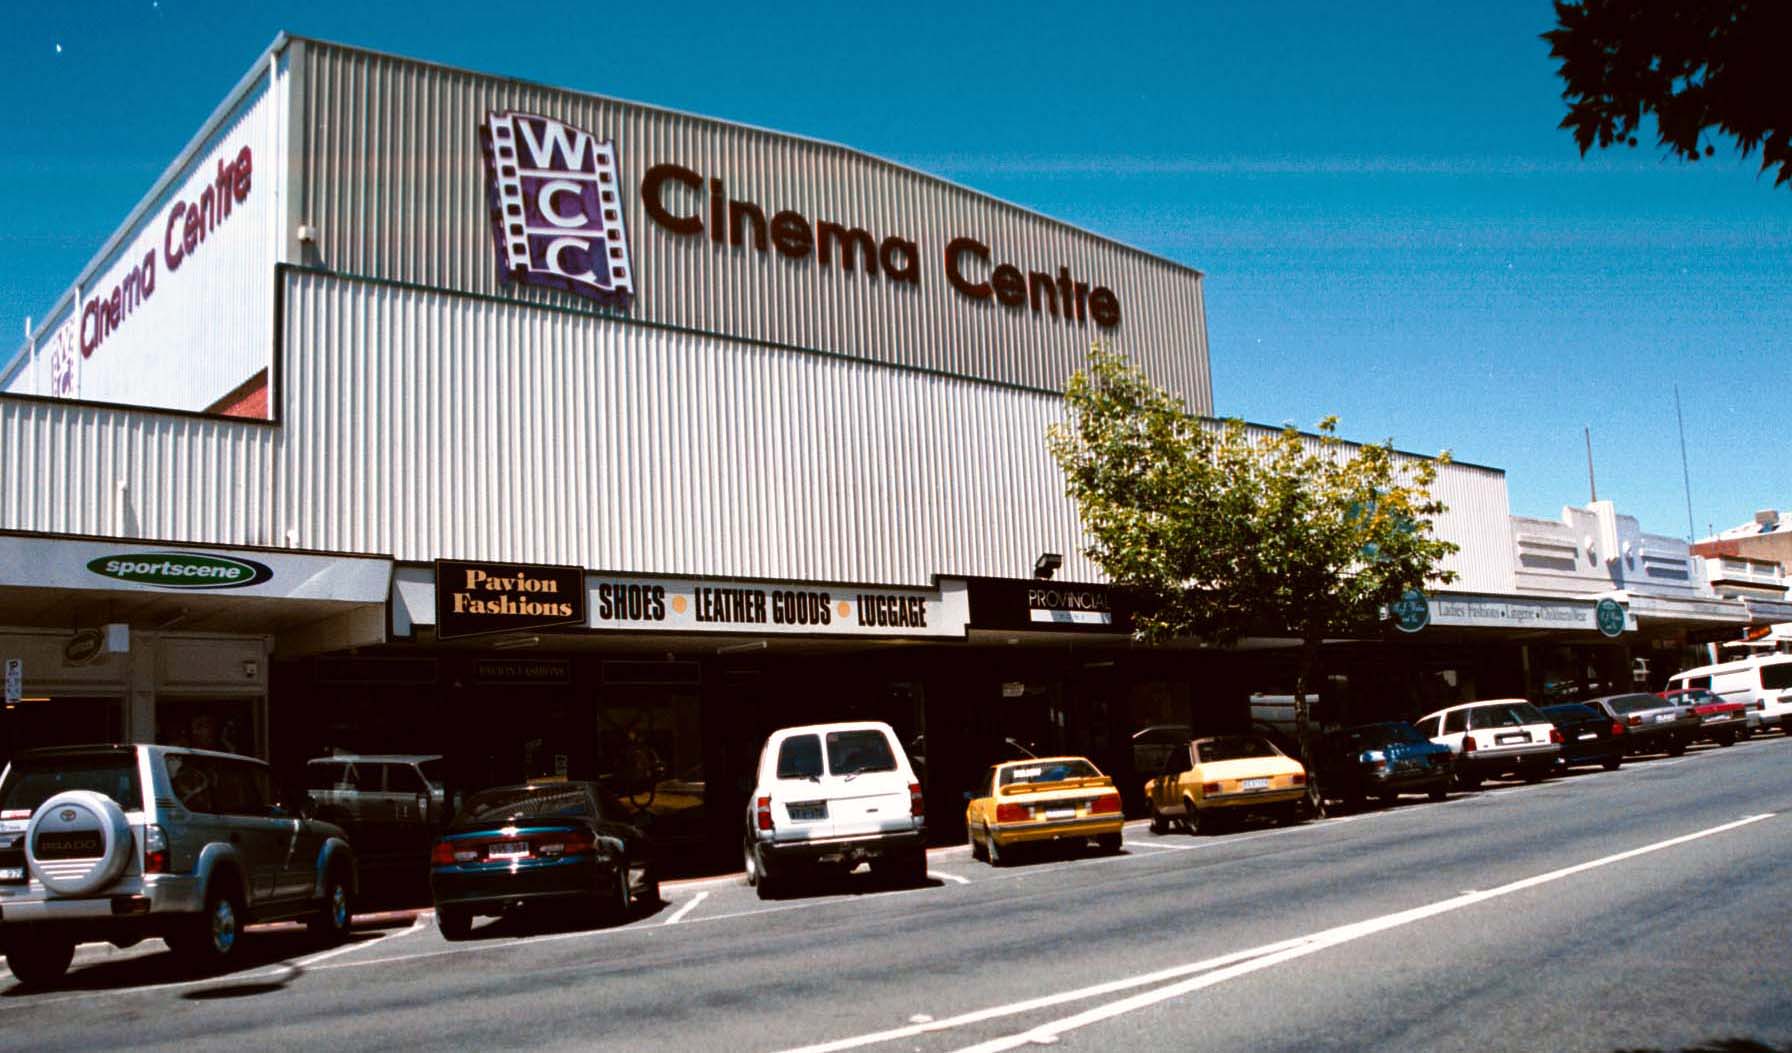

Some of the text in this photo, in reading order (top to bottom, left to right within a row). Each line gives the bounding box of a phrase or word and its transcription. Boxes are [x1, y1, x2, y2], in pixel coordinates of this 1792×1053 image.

[164, 145, 253, 272] Centre
[641, 163, 1121, 328] Cinema Centre
[105, 557, 242, 580] sportscene
[465, 569, 560, 593] Pavion
[452, 592, 573, 617] Fashions
[599, 583, 928, 628] SHOES LEATHER GOODS LUGGAGE
[1028, 589, 1112, 610] PROVINCIAL
